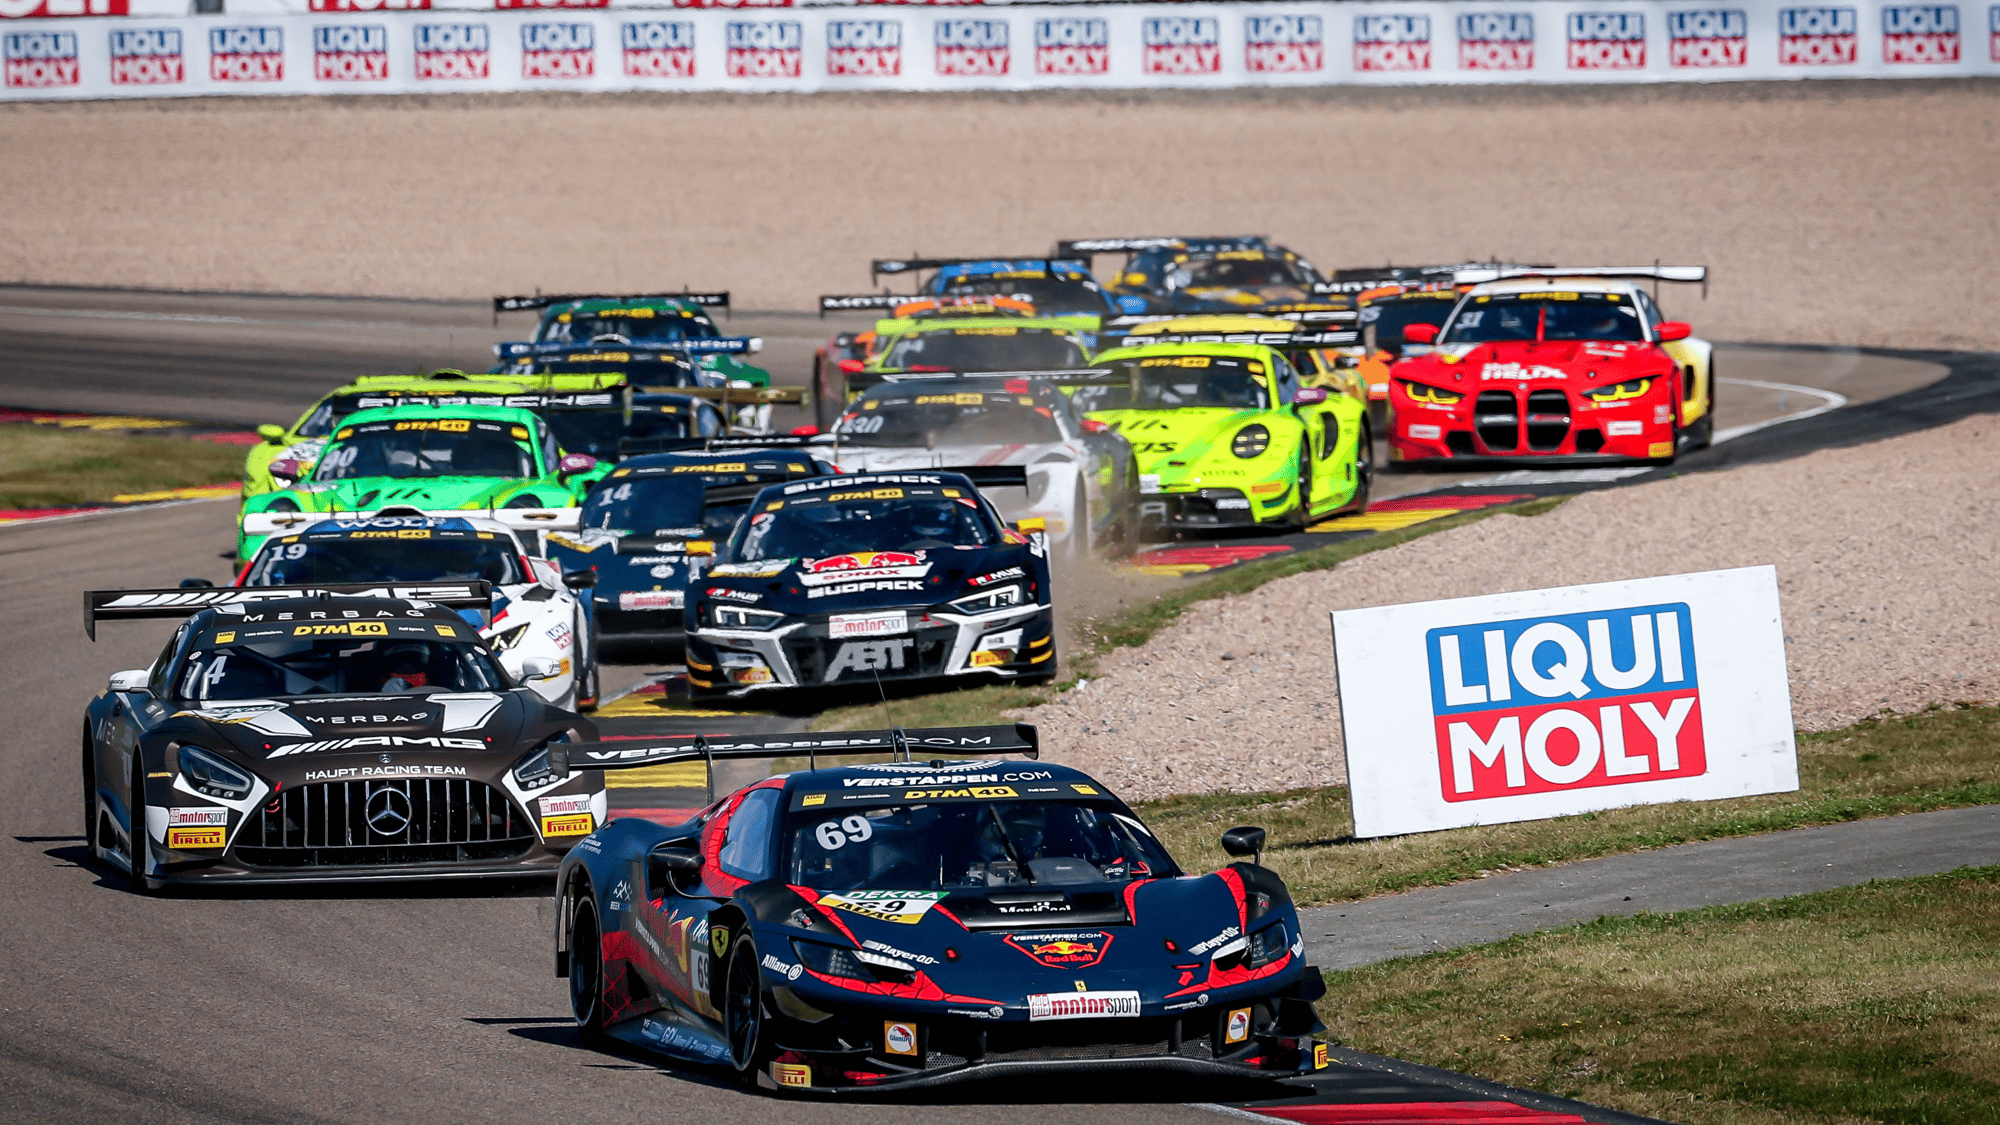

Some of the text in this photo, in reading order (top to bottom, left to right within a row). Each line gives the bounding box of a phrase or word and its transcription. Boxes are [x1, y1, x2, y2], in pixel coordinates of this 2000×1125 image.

[1037, 21, 1104, 48] LIQUI
[1146, 20, 1215, 47] LIQUI
[1248, 18, 1318, 46] LIQUI
[1356, 17, 1427, 44] LIQUI
[1460, 15, 1530, 43] LIQUI
[1570, 15, 1643, 42] LIQUI
[1671, 11, 1742, 39] LIQUI
[1782, 10, 1853, 37] LIQUI
[1885, 9, 1955, 35] LIQUI
[8, 34, 74, 58] LIQUI
[114, 33, 179, 56] LIQUI
[213, 30, 280, 54] LIQUI
[317, 28, 384, 53] LIQUI
[417, 27, 485, 52] LIQUI
[525, 26, 590, 52] LIQUI
[625, 25, 691, 51] LIQUI
[730, 24, 798, 50] LIQUI
[829, 23, 897, 49] LIQUI
[937, 22, 1005, 49] LIQUI
[1889, 33, 1958, 61] MOLY
[833, 49, 898, 73] MOLY
[941, 48, 1008, 73] MOLY
[1041, 47, 1106, 71] MOLY
[1152, 46, 1218, 71] MOLY
[1252, 43, 1320, 67] MOLY
[1361, 43, 1428, 67] MOLY
[1465, 42, 1531, 67] MOLY
[1572, 40, 1644, 66] MOLY
[1674, 38, 1744, 65] MOLY
[1785, 35, 1854, 62] MOLY
[9, 59, 77, 84] MOLY
[116, 56, 182, 81] MOLY
[215, 53, 281, 79] MOLY
[319, 52, 386, 78] MOLY
[420, 51, 486, 76] MOLY
[528, 51, 591, 75] MOLY
[628, 49, 692, 74] MOLY
[732, 50, 799, 75] MOLY
[599, 483, 632, 506] 14
[268, 543, 307, 562] 19
[242, 609, 425, 623] MERBAG
[294, 624, 382, 636] DTM 40
[824, 638, 913, 682] ABT
[1439, 611, 1684, 706] LIQUI
[306, 711, 428, 724] MERBAG
[1448, 697, 1696, 793] MOLY
[306, 765, 467, 780] HAUPT RACING TEAM
[843, 771, 1052, 787] VERSTAPPEN.COM
[904, 787, 1009, 799] DTM 40
[180, 812, 226, 824] motorsport
[547, 819, 588, 832] PIRELLI
[173, 832, 220, 844] PIRELLI
[815, 815, 872, 850] 69
[847, 890, 939, 900] DEKRA
[836, 902, 903, 921] ADAC
[1012, 933, 1102, 941] VERSTAPPEN.COM
[761, 954, 790, 975] Allianz
[1044, 953, 1094, 963] Red Bull
[1052, 994, 1139, 1016] motorsport
